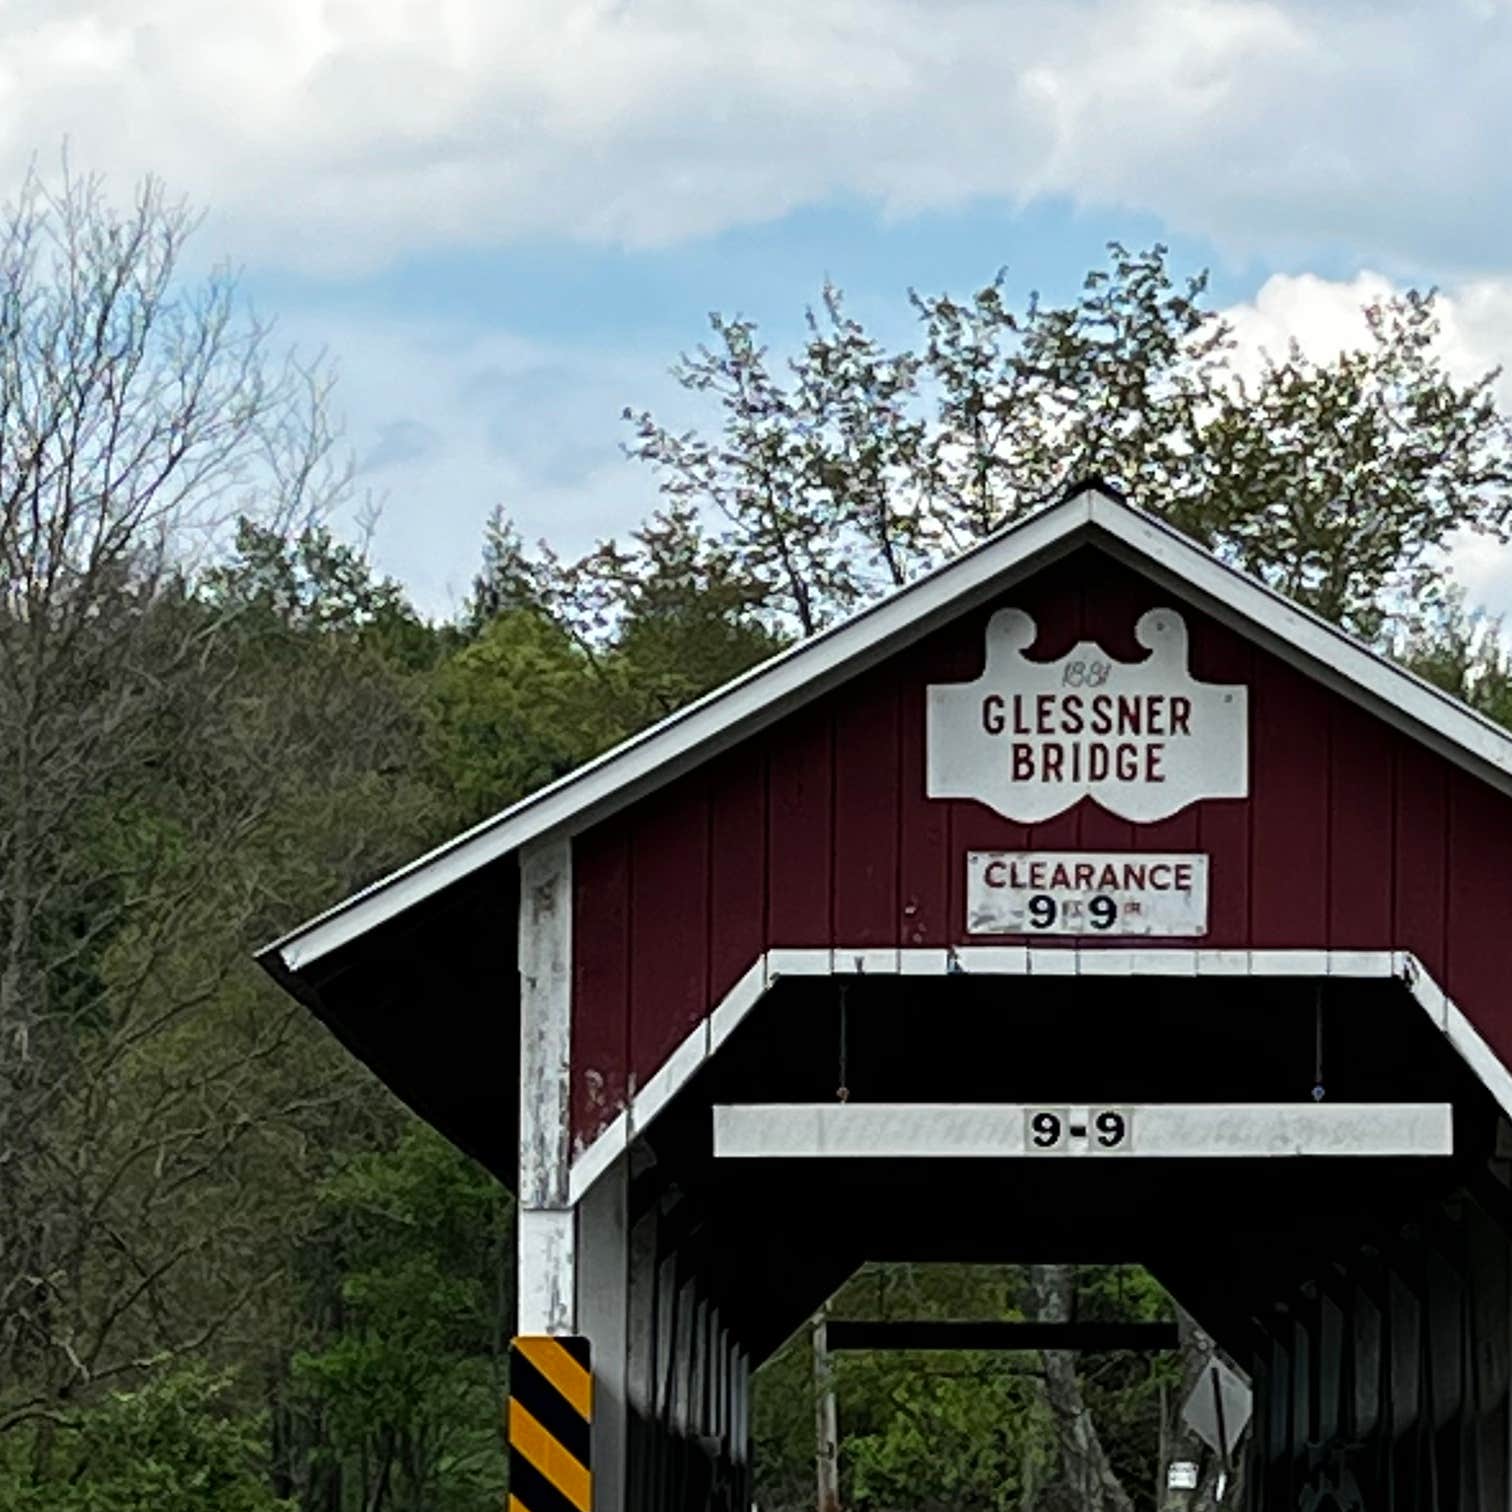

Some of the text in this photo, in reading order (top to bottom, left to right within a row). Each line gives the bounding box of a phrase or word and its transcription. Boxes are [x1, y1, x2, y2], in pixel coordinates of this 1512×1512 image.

[982, 694, 1192, 736] GLESSNER
[1011, 743, 1166, 783] BRIDGE
[984, 861, 1192, 891] CLEARANCE
[1028, 895, 1057, 929] 9
[1088, 895, 1117, 929] 9
[1032, 1111, 1126, 1148] 9-9
